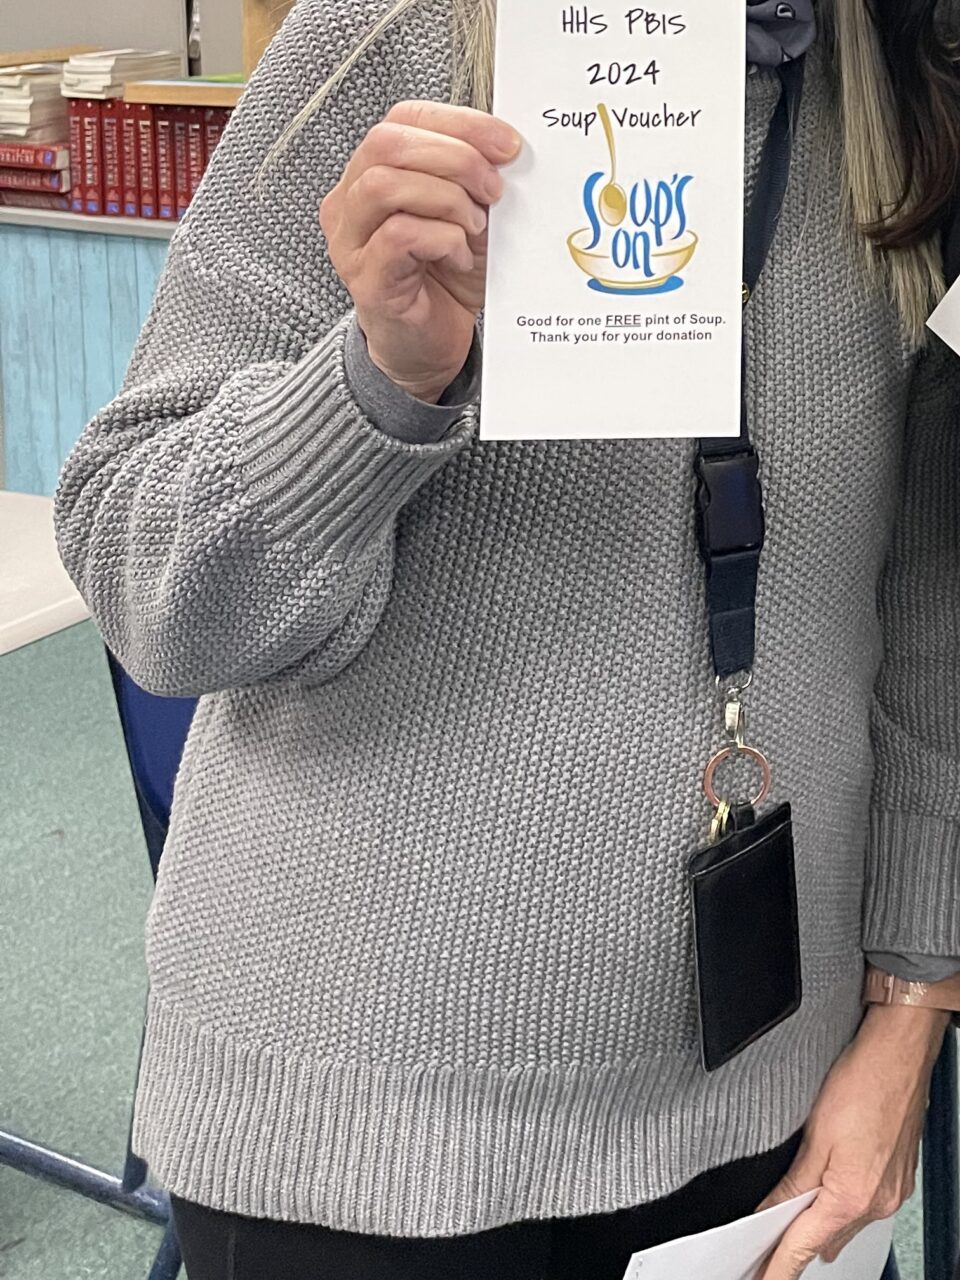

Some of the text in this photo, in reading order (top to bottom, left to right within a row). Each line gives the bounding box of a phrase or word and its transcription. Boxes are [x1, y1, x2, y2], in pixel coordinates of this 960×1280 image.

[562, 6, 686, 35] HHS PBIS
[586, 60, 660, 85] 2024
[542, 103, 702, 136] Soup Voucher
[516, 313, 727, 328] Good for one FREE pint of Soup.
[530, 329, 713, 345] Thank you for your donation
